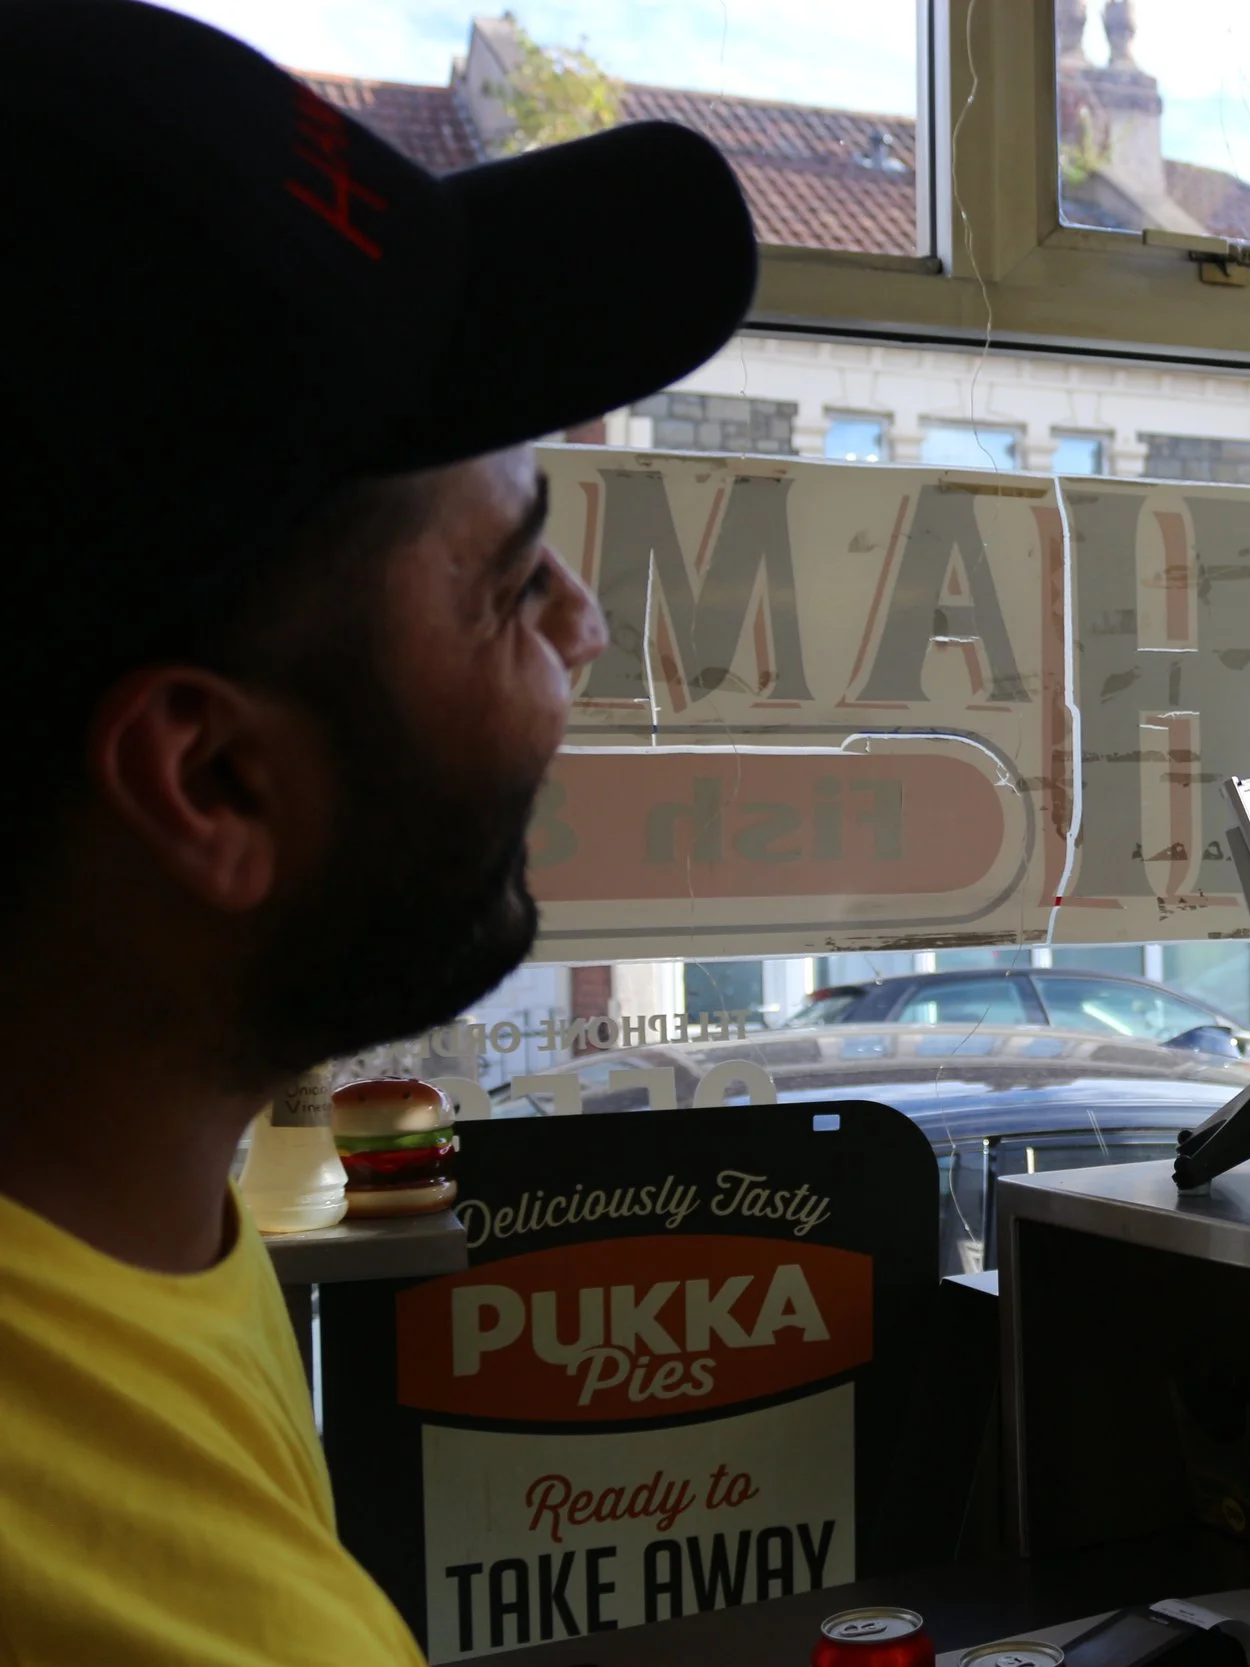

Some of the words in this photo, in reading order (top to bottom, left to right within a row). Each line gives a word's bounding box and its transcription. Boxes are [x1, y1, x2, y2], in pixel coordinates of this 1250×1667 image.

[455, 1175, 701, 1249] Deliciously
[711, 1170, 832, 1236] Tasty
[451, 1263, 830, 1377] PUKKA
[566, 1345, 717, 1406] Pies
[525, 1468, 694, 1542] Ready
[704, 1464, 759, 1510] to
[445, 1545, 620, 1652] TAKE
[642, 1519, 836, 1623] AWAY
